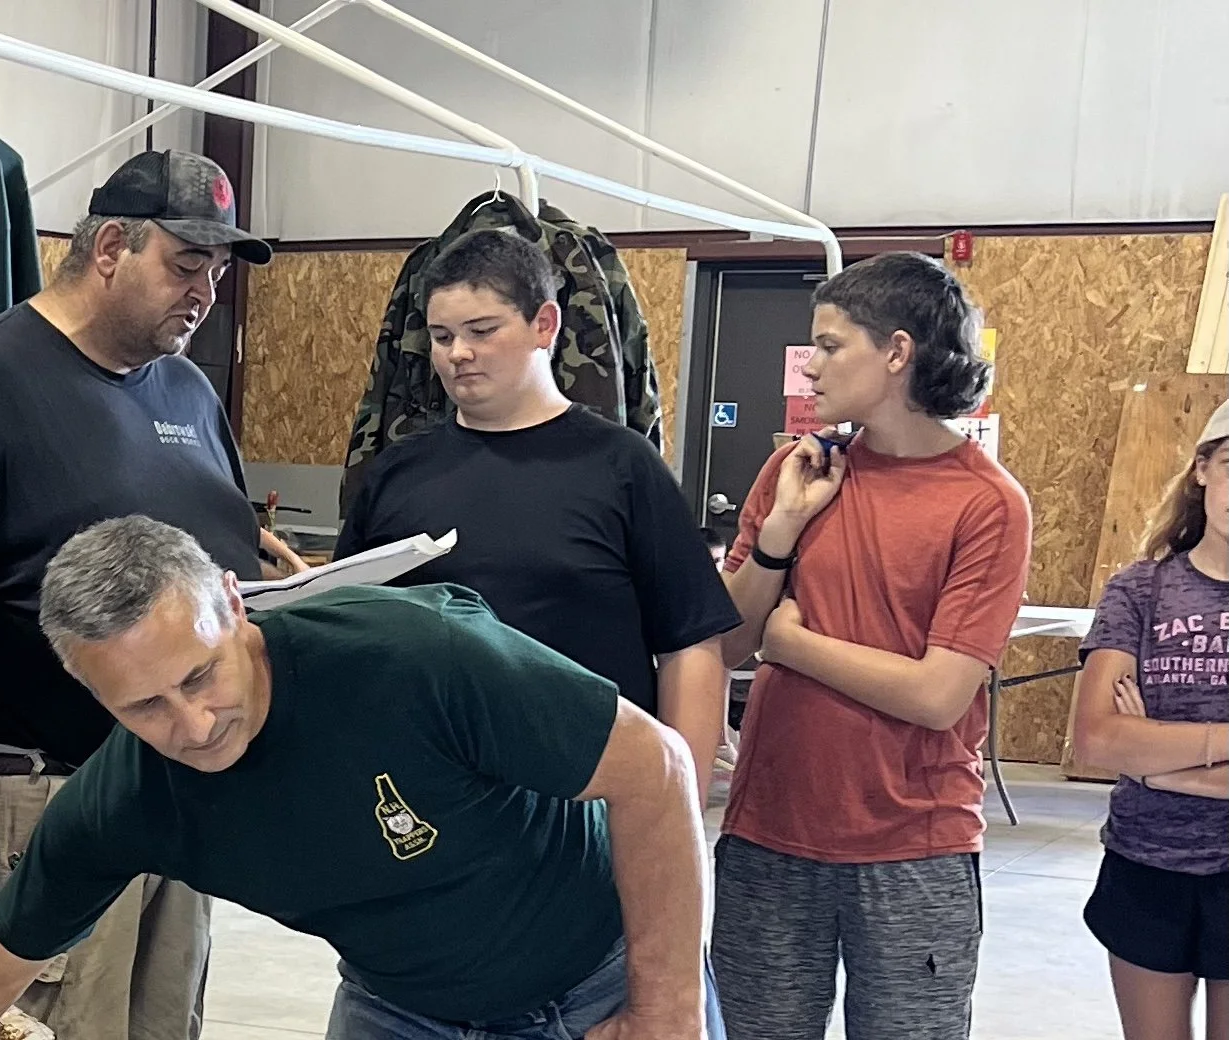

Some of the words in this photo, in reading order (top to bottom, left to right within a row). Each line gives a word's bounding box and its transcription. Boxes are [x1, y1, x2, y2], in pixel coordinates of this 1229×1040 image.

[794, 350, 810, 359] NO
[1153, 614, 1204, 642] ZAC
[1143, 656, 1229, 673] SOUTHERN
